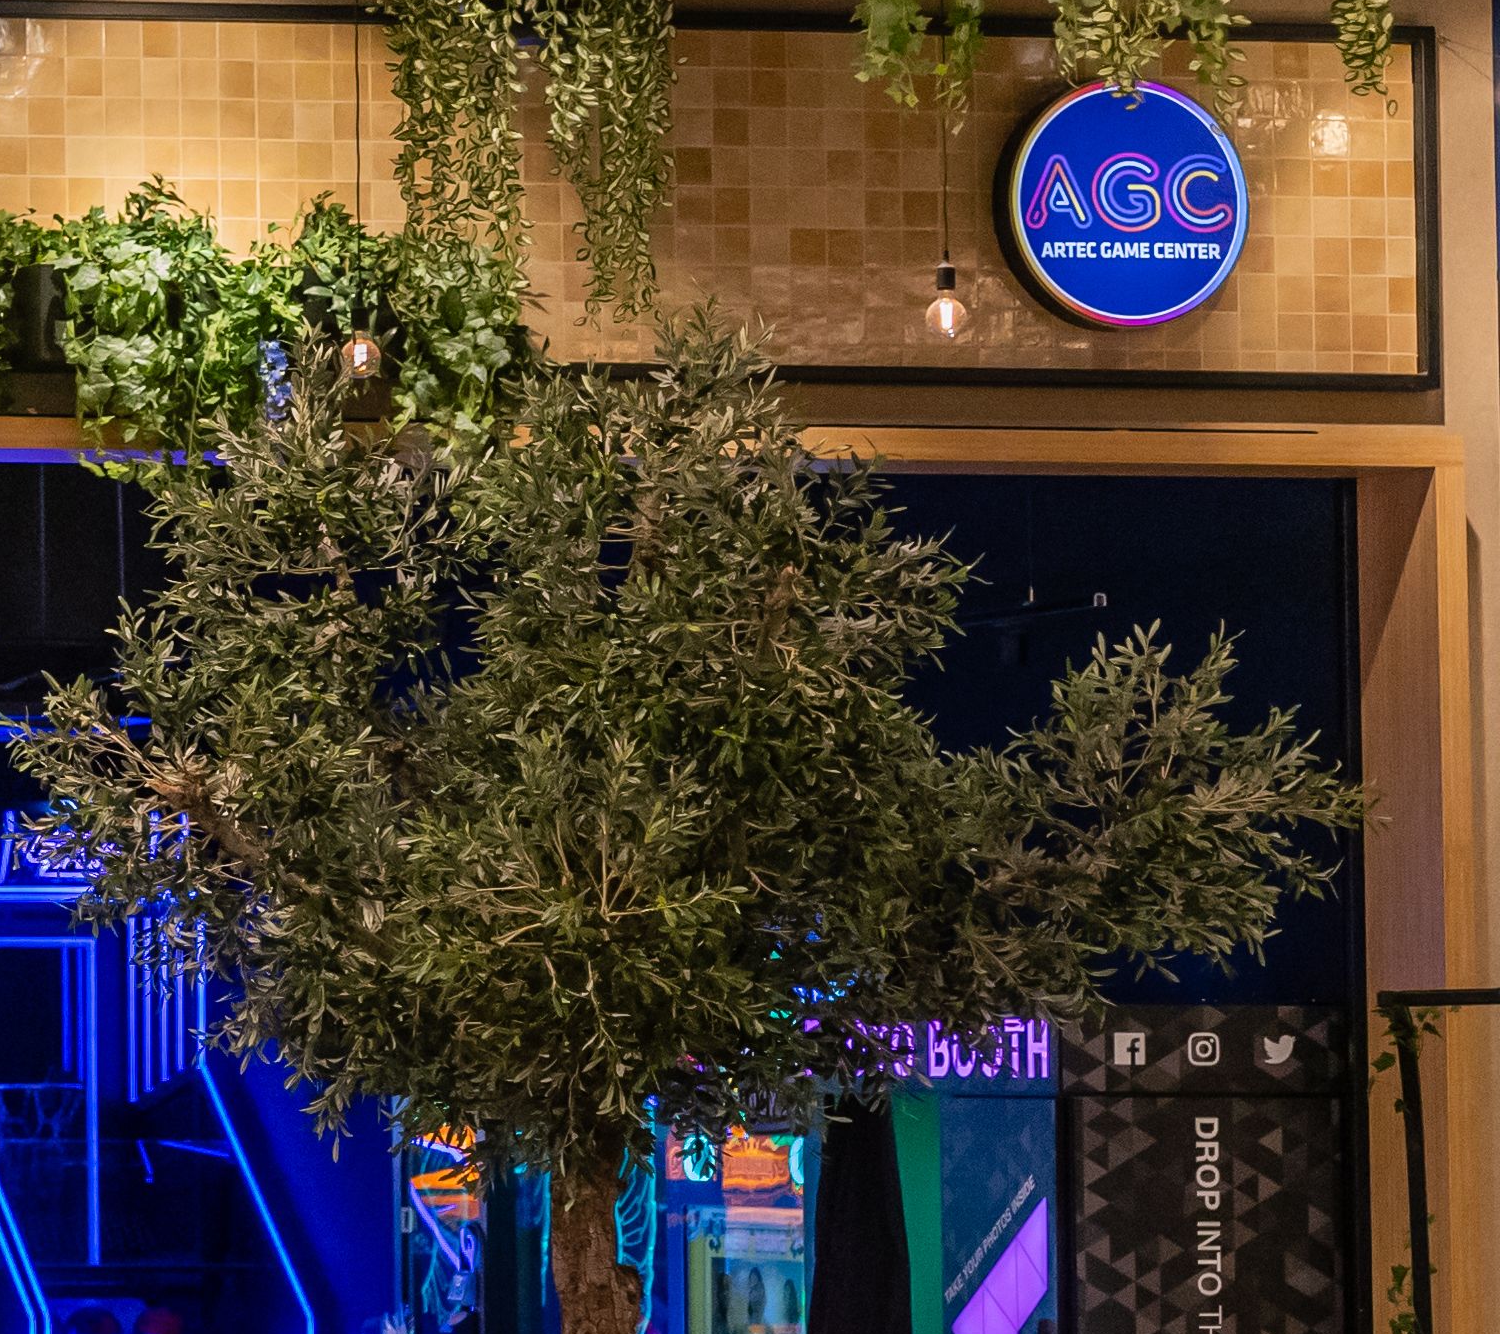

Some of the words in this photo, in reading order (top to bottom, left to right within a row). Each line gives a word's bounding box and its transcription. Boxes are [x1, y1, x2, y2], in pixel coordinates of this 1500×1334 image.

[1025, 152, 1233, 234] AGC
[1041, 241, 1098, 259] ARTEC
[1100, 242, 1151, 259] GAME
[1153, 242, 1222, 261] CENTER
[1195, 1117, 1220, 1211] DROP
[1197, 1221, 1222, 1296] INTO
